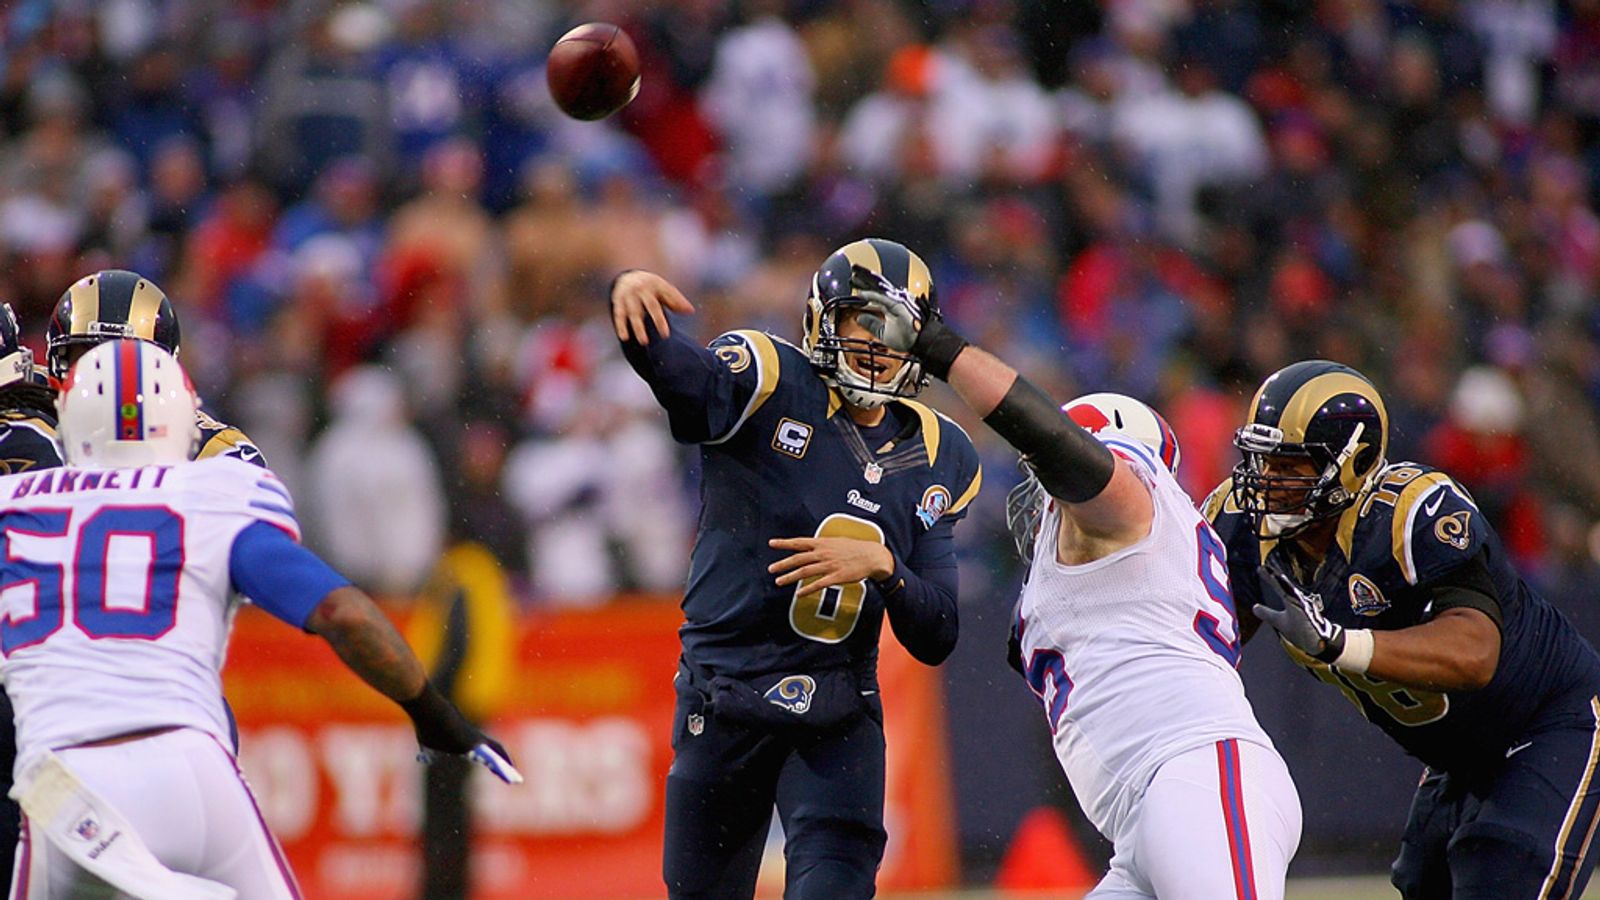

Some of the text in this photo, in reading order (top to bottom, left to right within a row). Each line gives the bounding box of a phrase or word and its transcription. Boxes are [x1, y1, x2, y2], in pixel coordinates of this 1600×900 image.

[778, 421, 809, 448] C
[847, 489, 881, 513] Rams
[0, 504, 186, 658] 50
